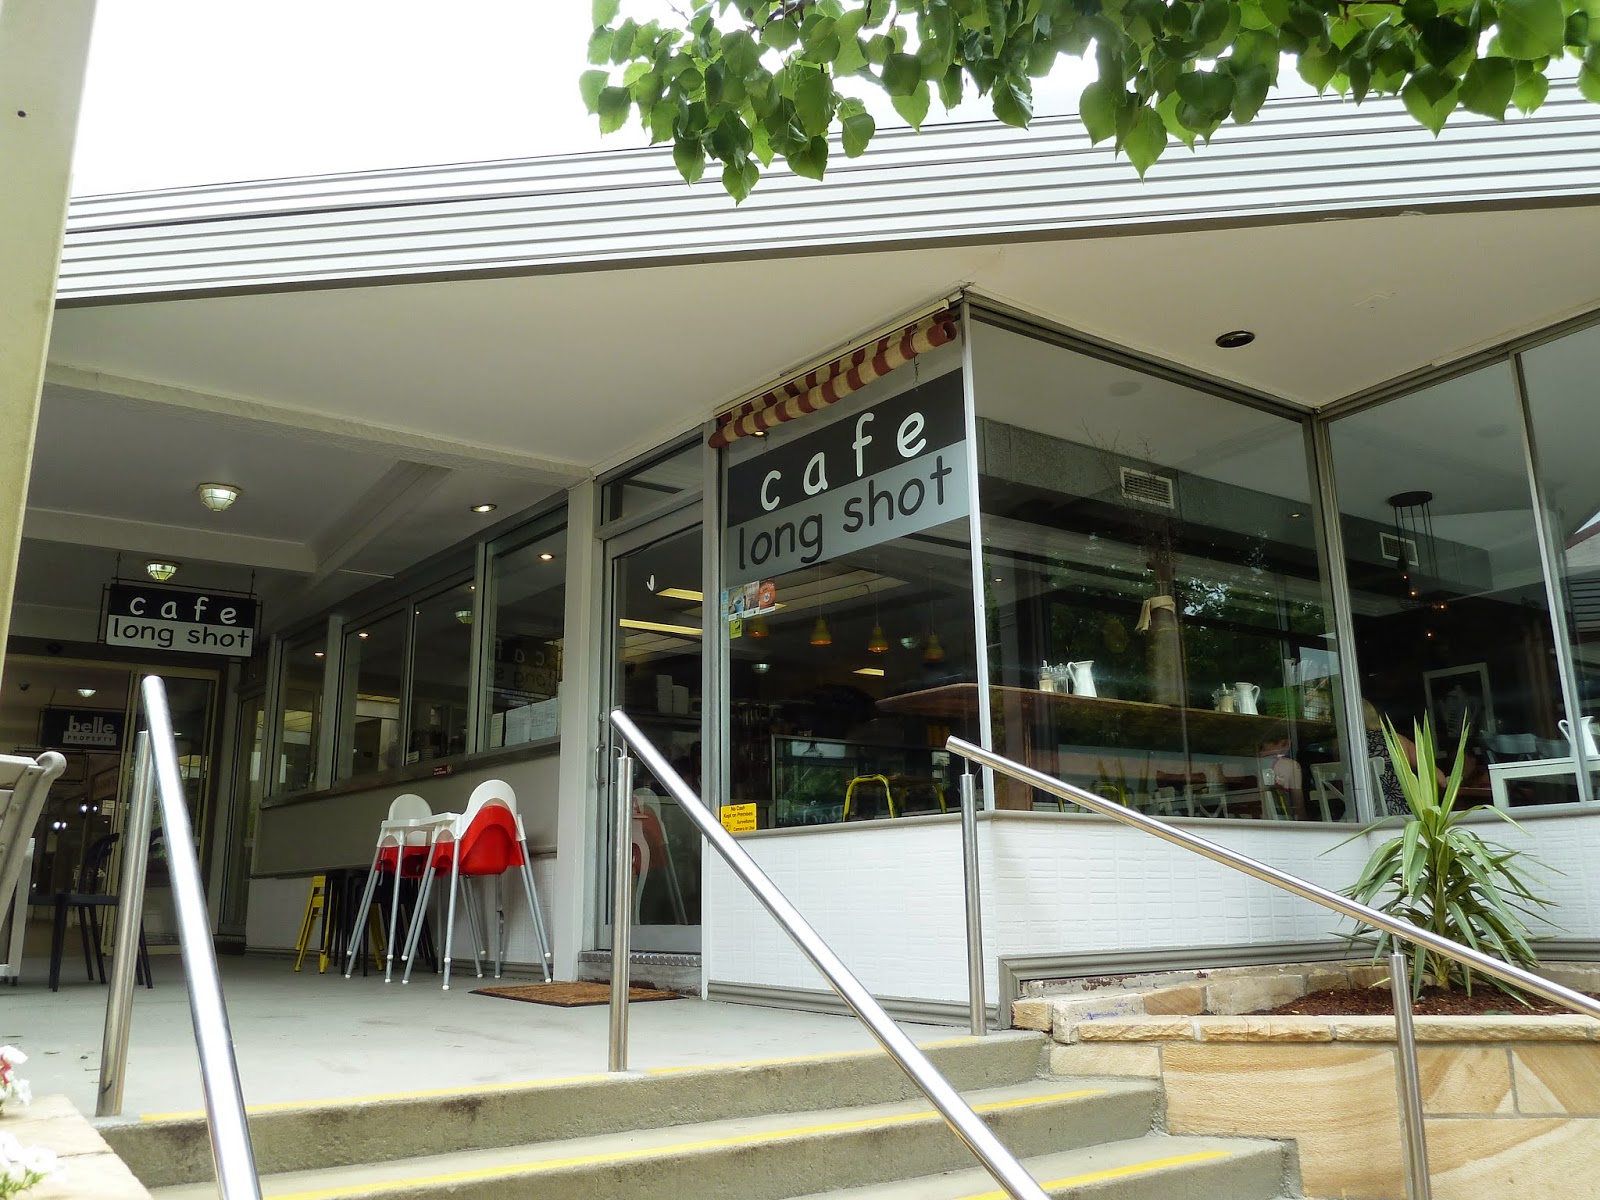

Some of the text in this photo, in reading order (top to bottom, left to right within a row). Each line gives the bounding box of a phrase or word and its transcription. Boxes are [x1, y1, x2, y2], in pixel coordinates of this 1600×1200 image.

[760, 411, 927, 512] cafe
[738, 455, 953, 571] long shot
[129, 596, 237, 625] cafe
[113, 617, 250, 649] long shot
[67, 734, 113, 743] PROPERTY
[68, 715, 115, 735] belle
